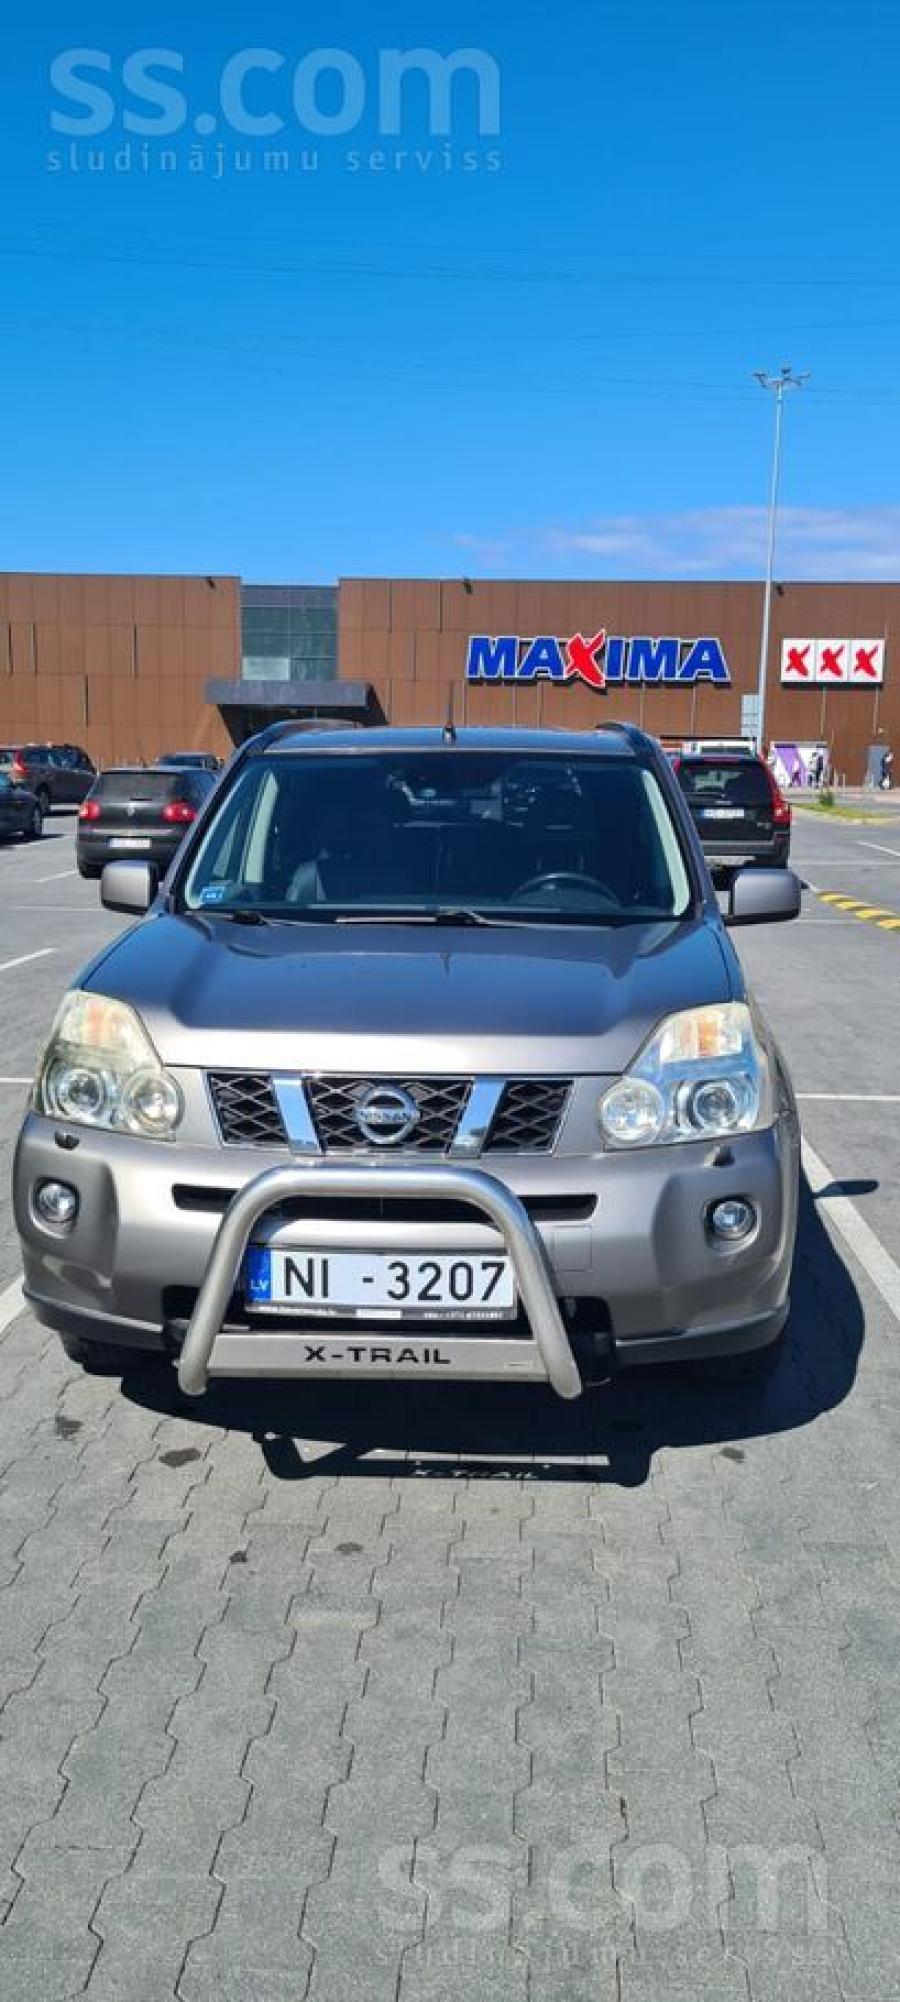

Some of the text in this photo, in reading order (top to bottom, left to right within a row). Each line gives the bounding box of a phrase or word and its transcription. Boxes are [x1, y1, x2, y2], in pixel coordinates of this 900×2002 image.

[466, 629, 731, 687] MAXIMA
[284, 1258, 328, 1298] NI
[304, 1345, 451, 1364] X-TRAIL
